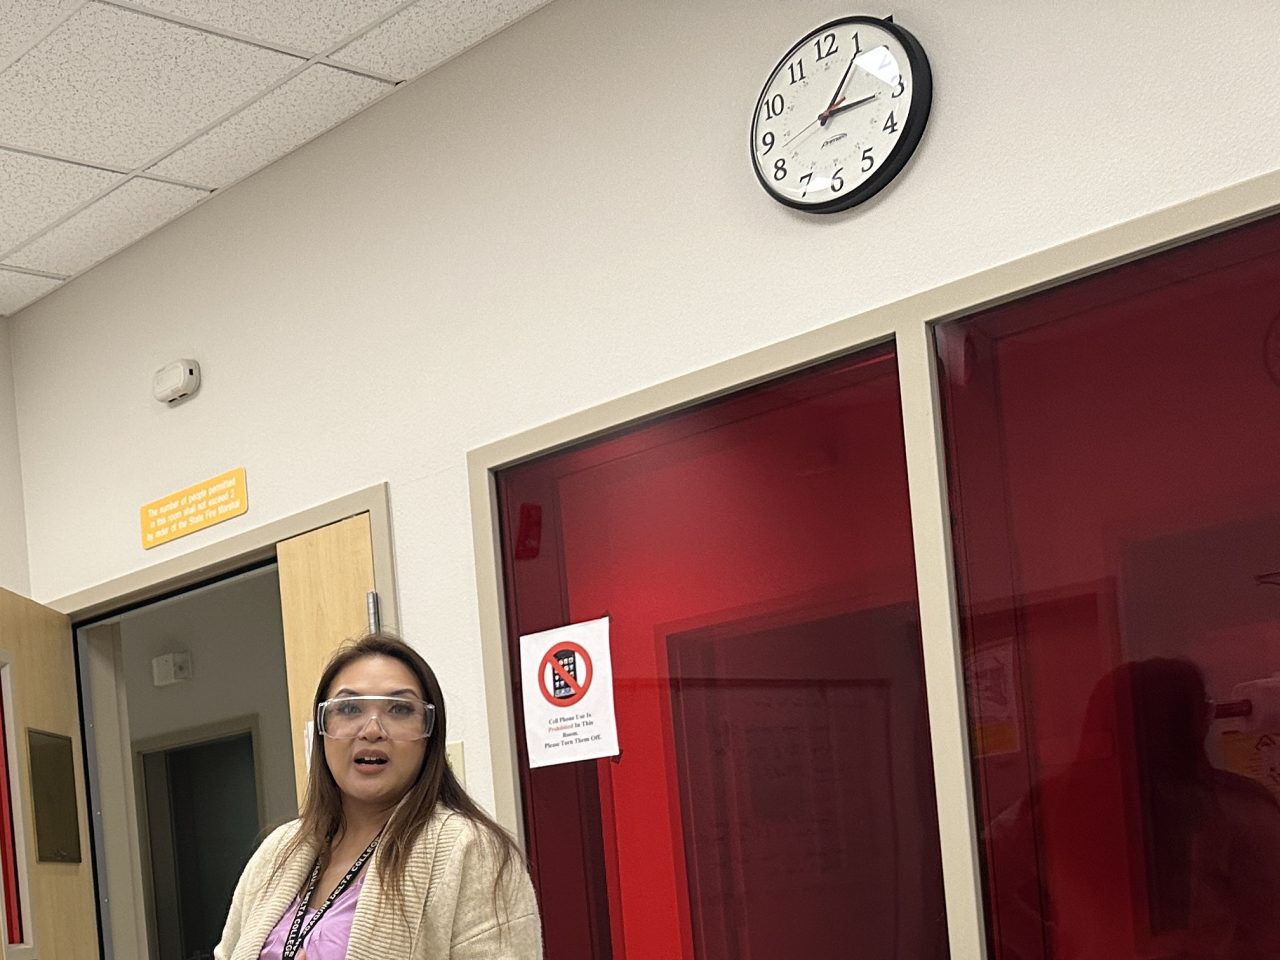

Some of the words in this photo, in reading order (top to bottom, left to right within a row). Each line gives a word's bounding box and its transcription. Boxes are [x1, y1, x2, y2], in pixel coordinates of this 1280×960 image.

[814, 33, 838, 62] 12
[852, 32, 862, 54] 1
[788, 59, 806, 85] 11
[891, 74, 904, 98] 3
[764, 94, 784, 121] 10
[882, 110, 898, 134] 4
[762, 132, 774, 156] 9
[773, 158, 787, 181] 8
[861, 148, 874, 172] 5
[800, 172, 813, 198] 7
[831, 167, 844, 192] 6
[330, 873, 352, 900] DELTA
[284, 918, 300, 957] COLLEGE
